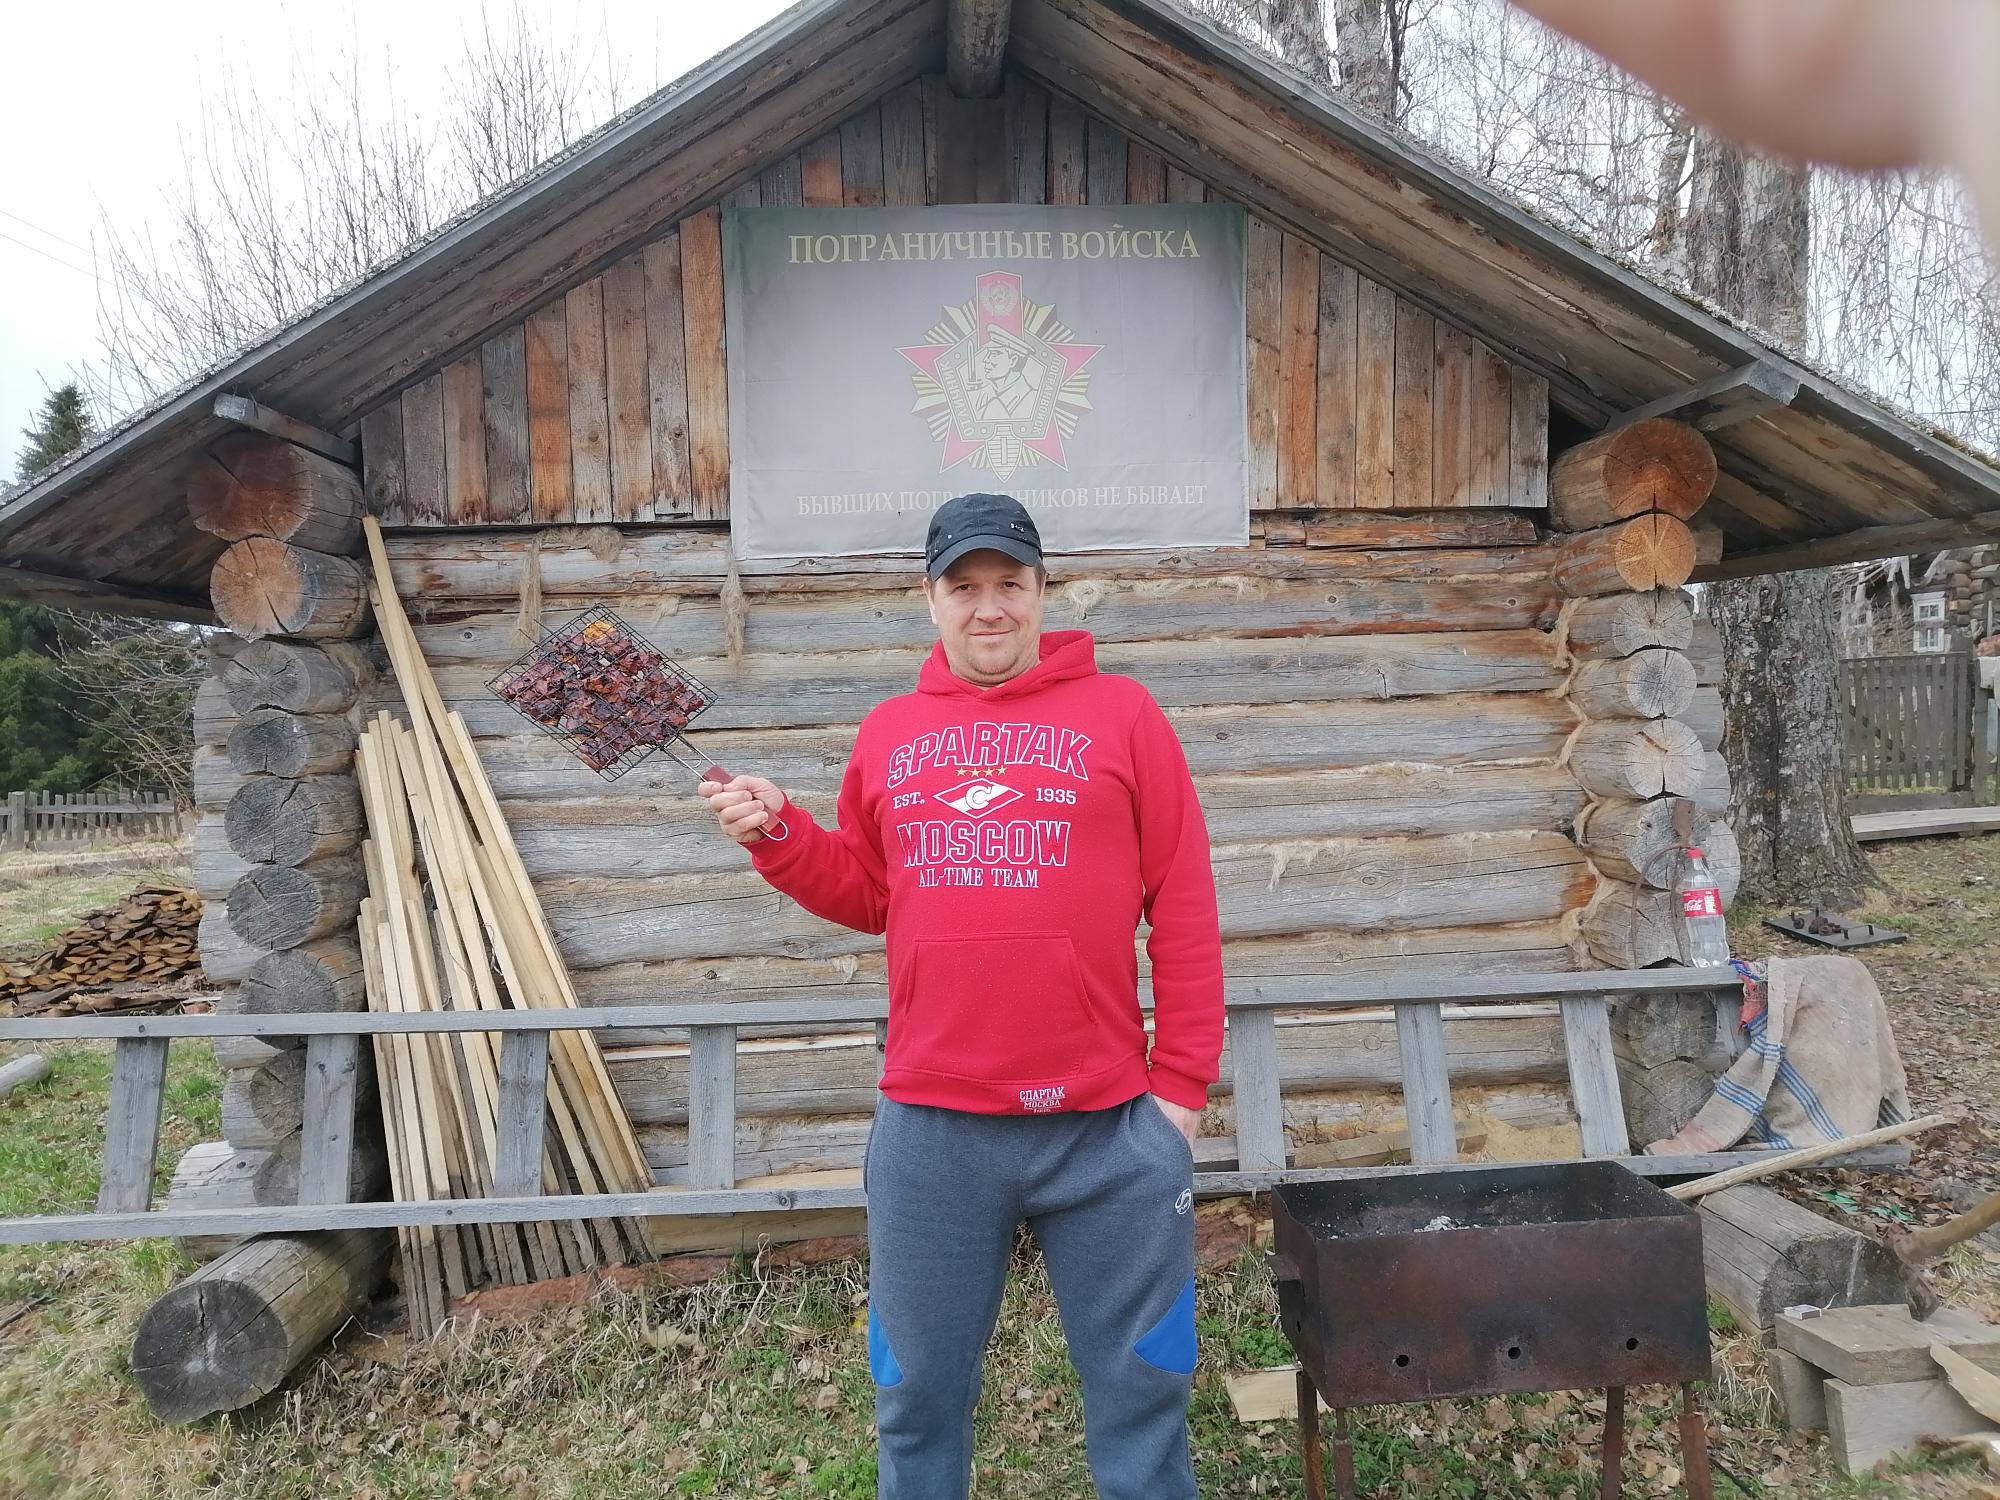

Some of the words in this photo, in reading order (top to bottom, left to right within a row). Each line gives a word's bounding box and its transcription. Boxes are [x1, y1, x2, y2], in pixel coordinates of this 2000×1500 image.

[788, 230, 1052, 264] ПОГРАНИЧНЫЕ
[1061, 223, 1202, 260] ВОЙСКА
[797, 490, 895, 516] БЫВШИХ
[899, 486, 1088, 512] ПОГРНИКОВ
[1093, 486, 1121, 506] НЕ
[1125, 484, 1208, 505] БЫВАЕТ
[887, 721, 1092, 789] SPARTAK
[892, 791, 925, 810] EST.
[1035, 787, 1077, 805] 1935
[896, 820, 1071, 868] MOSCOW
[991, 868, 1039, 889] TEAM
[1019, 1086, 1065, 1100] СПАРТАК
[1024, 1099, 1061, 1109] МОСКВА
